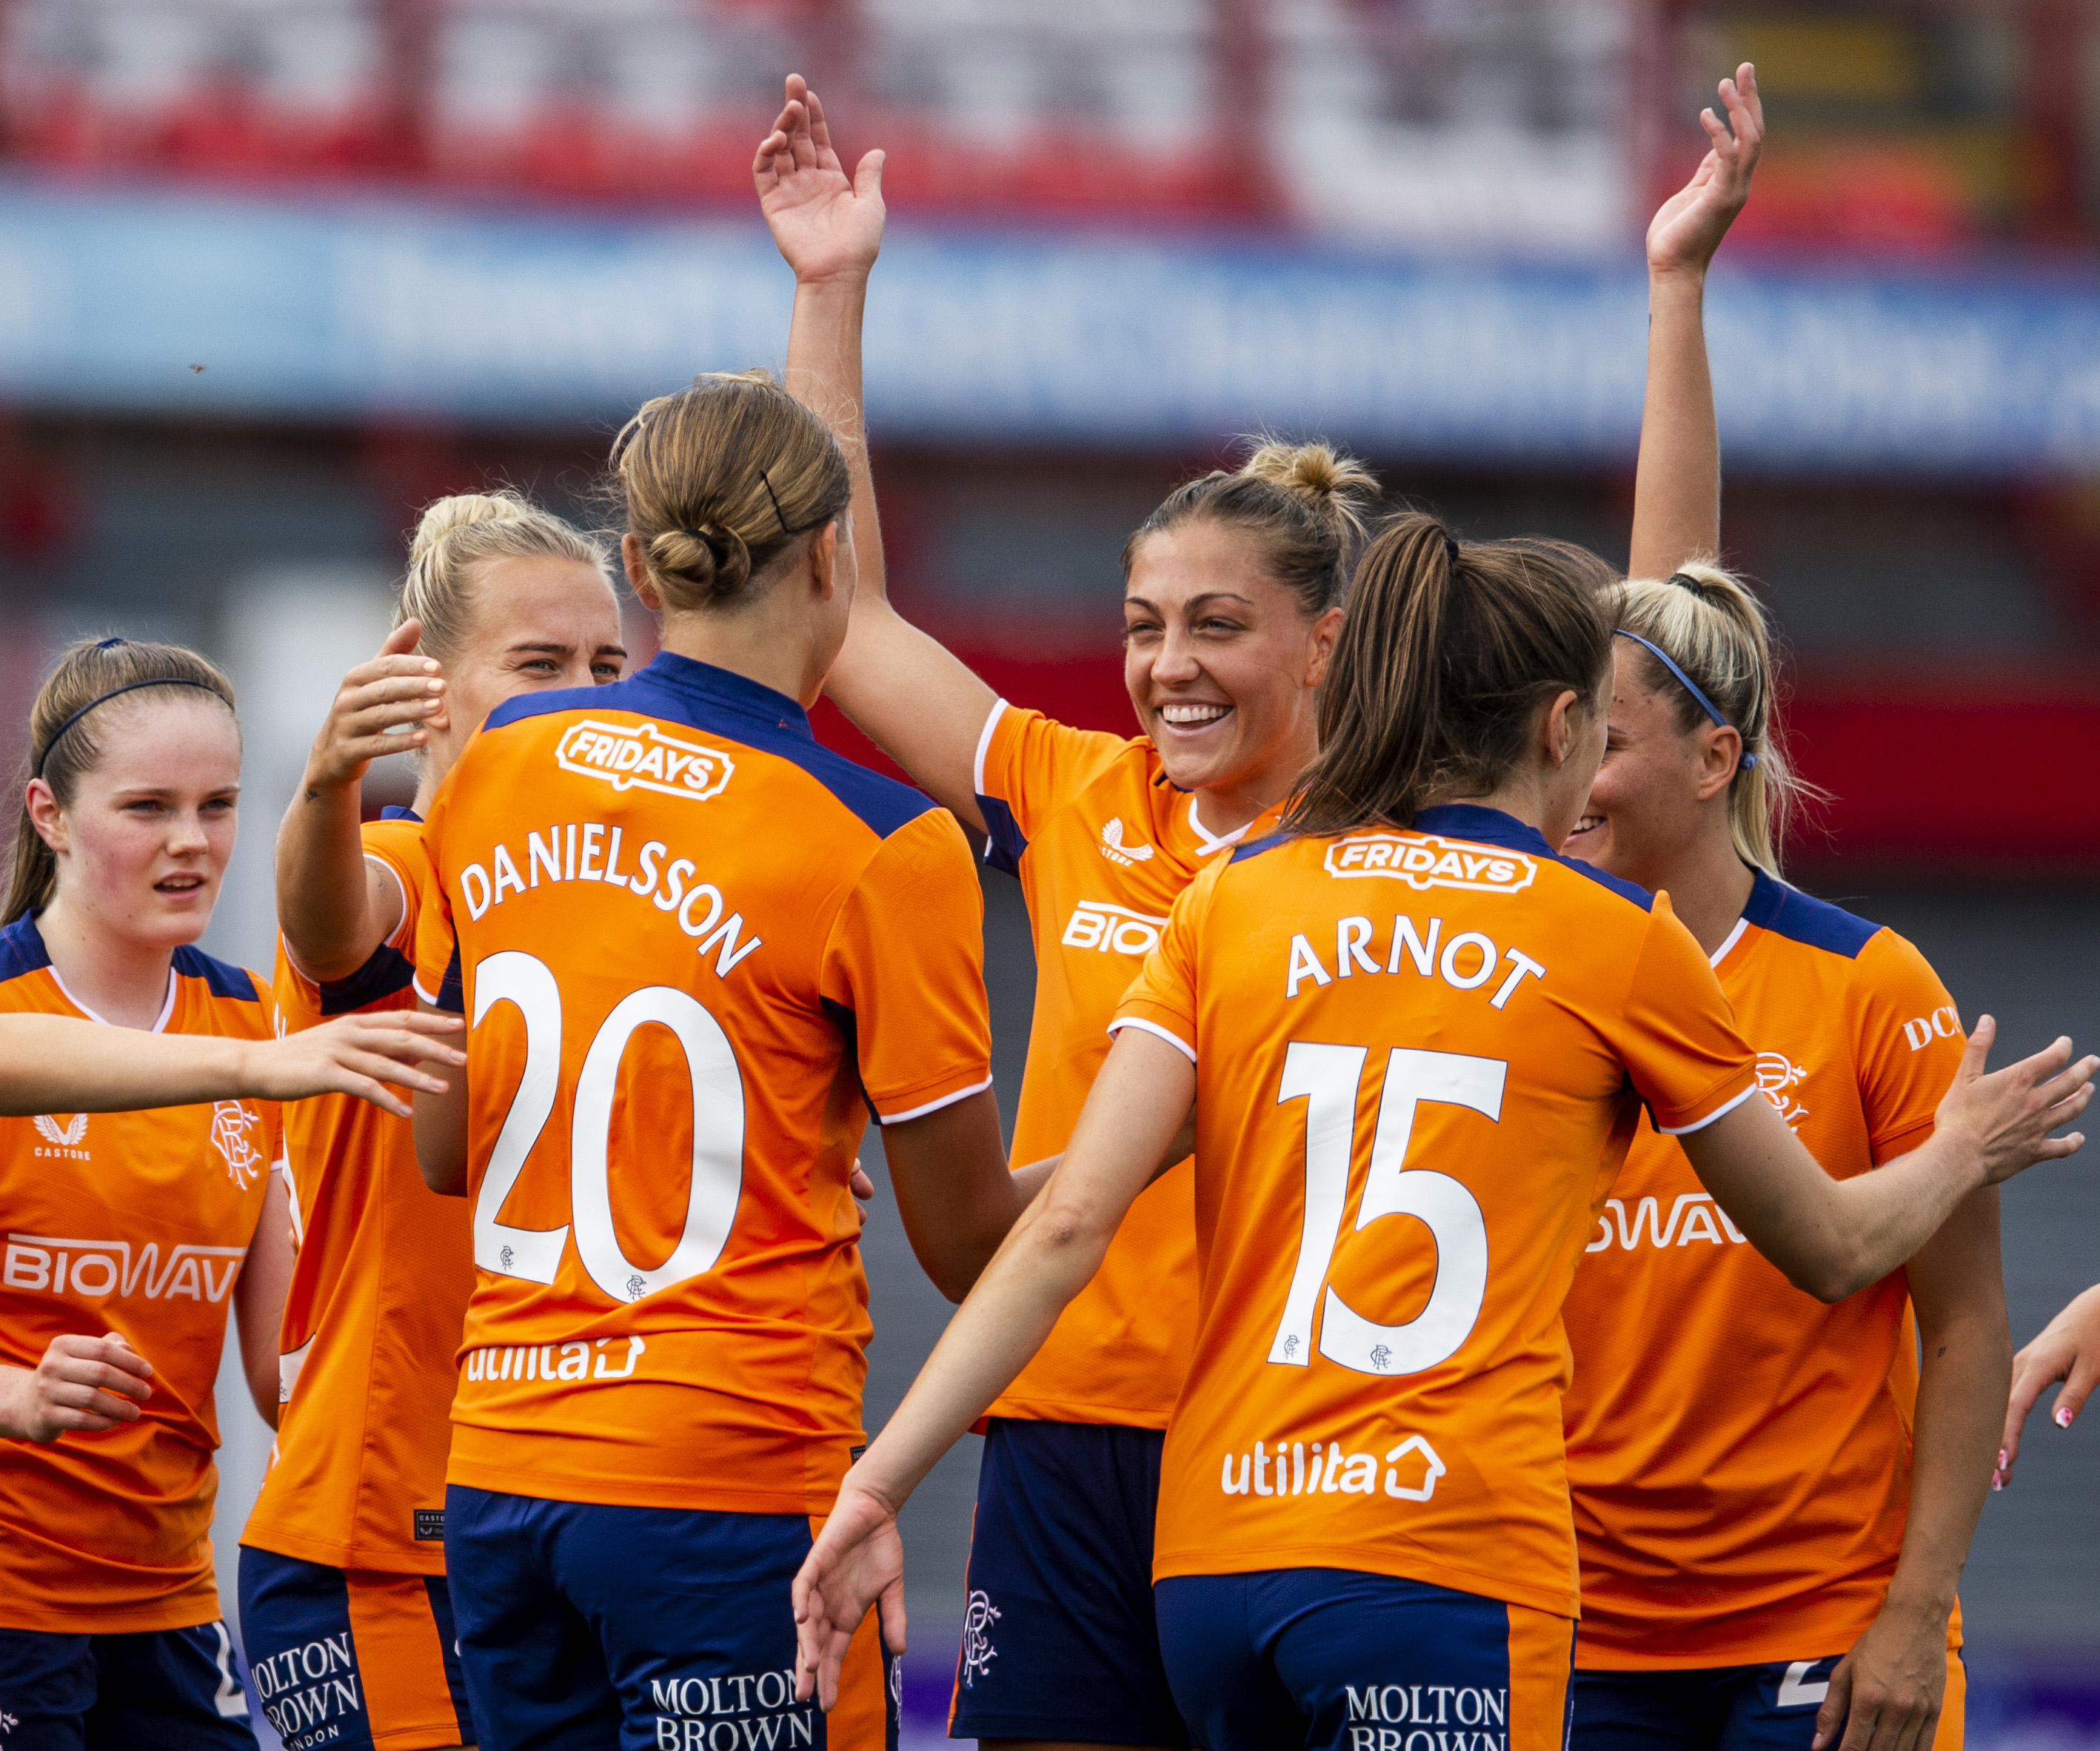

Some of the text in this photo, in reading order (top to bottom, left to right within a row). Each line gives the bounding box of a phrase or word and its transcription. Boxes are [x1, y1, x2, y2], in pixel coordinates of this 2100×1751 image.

[567, 730, 714, 789] FRIDAYS
[1338, 843, 1517, 883] FRIDAYS
[460, 822, 763, 980] DANIELSSON
[1061, 900, 1168, 954] BIO
[1285, 914, 1547, 1011] ARNOT
[34, 1147, 91, 1161] CASTORE
[472, 950, 746, 1304] 20
[1266, 1041, 1508, 1376] 15
[3, 1233, 249, 1303] BIOWAV
[1220, 1440, 1378, 1497] utilita
[251, 1632, 351, 1703] OLTON
[267, 1674, 359, 1738] ROWN
[656, 1709, 813, 1751] BROWN
[1345, 1684, 1507, 1726] MOLTON
[1348, 1727, 1506, 1751] BROWN
